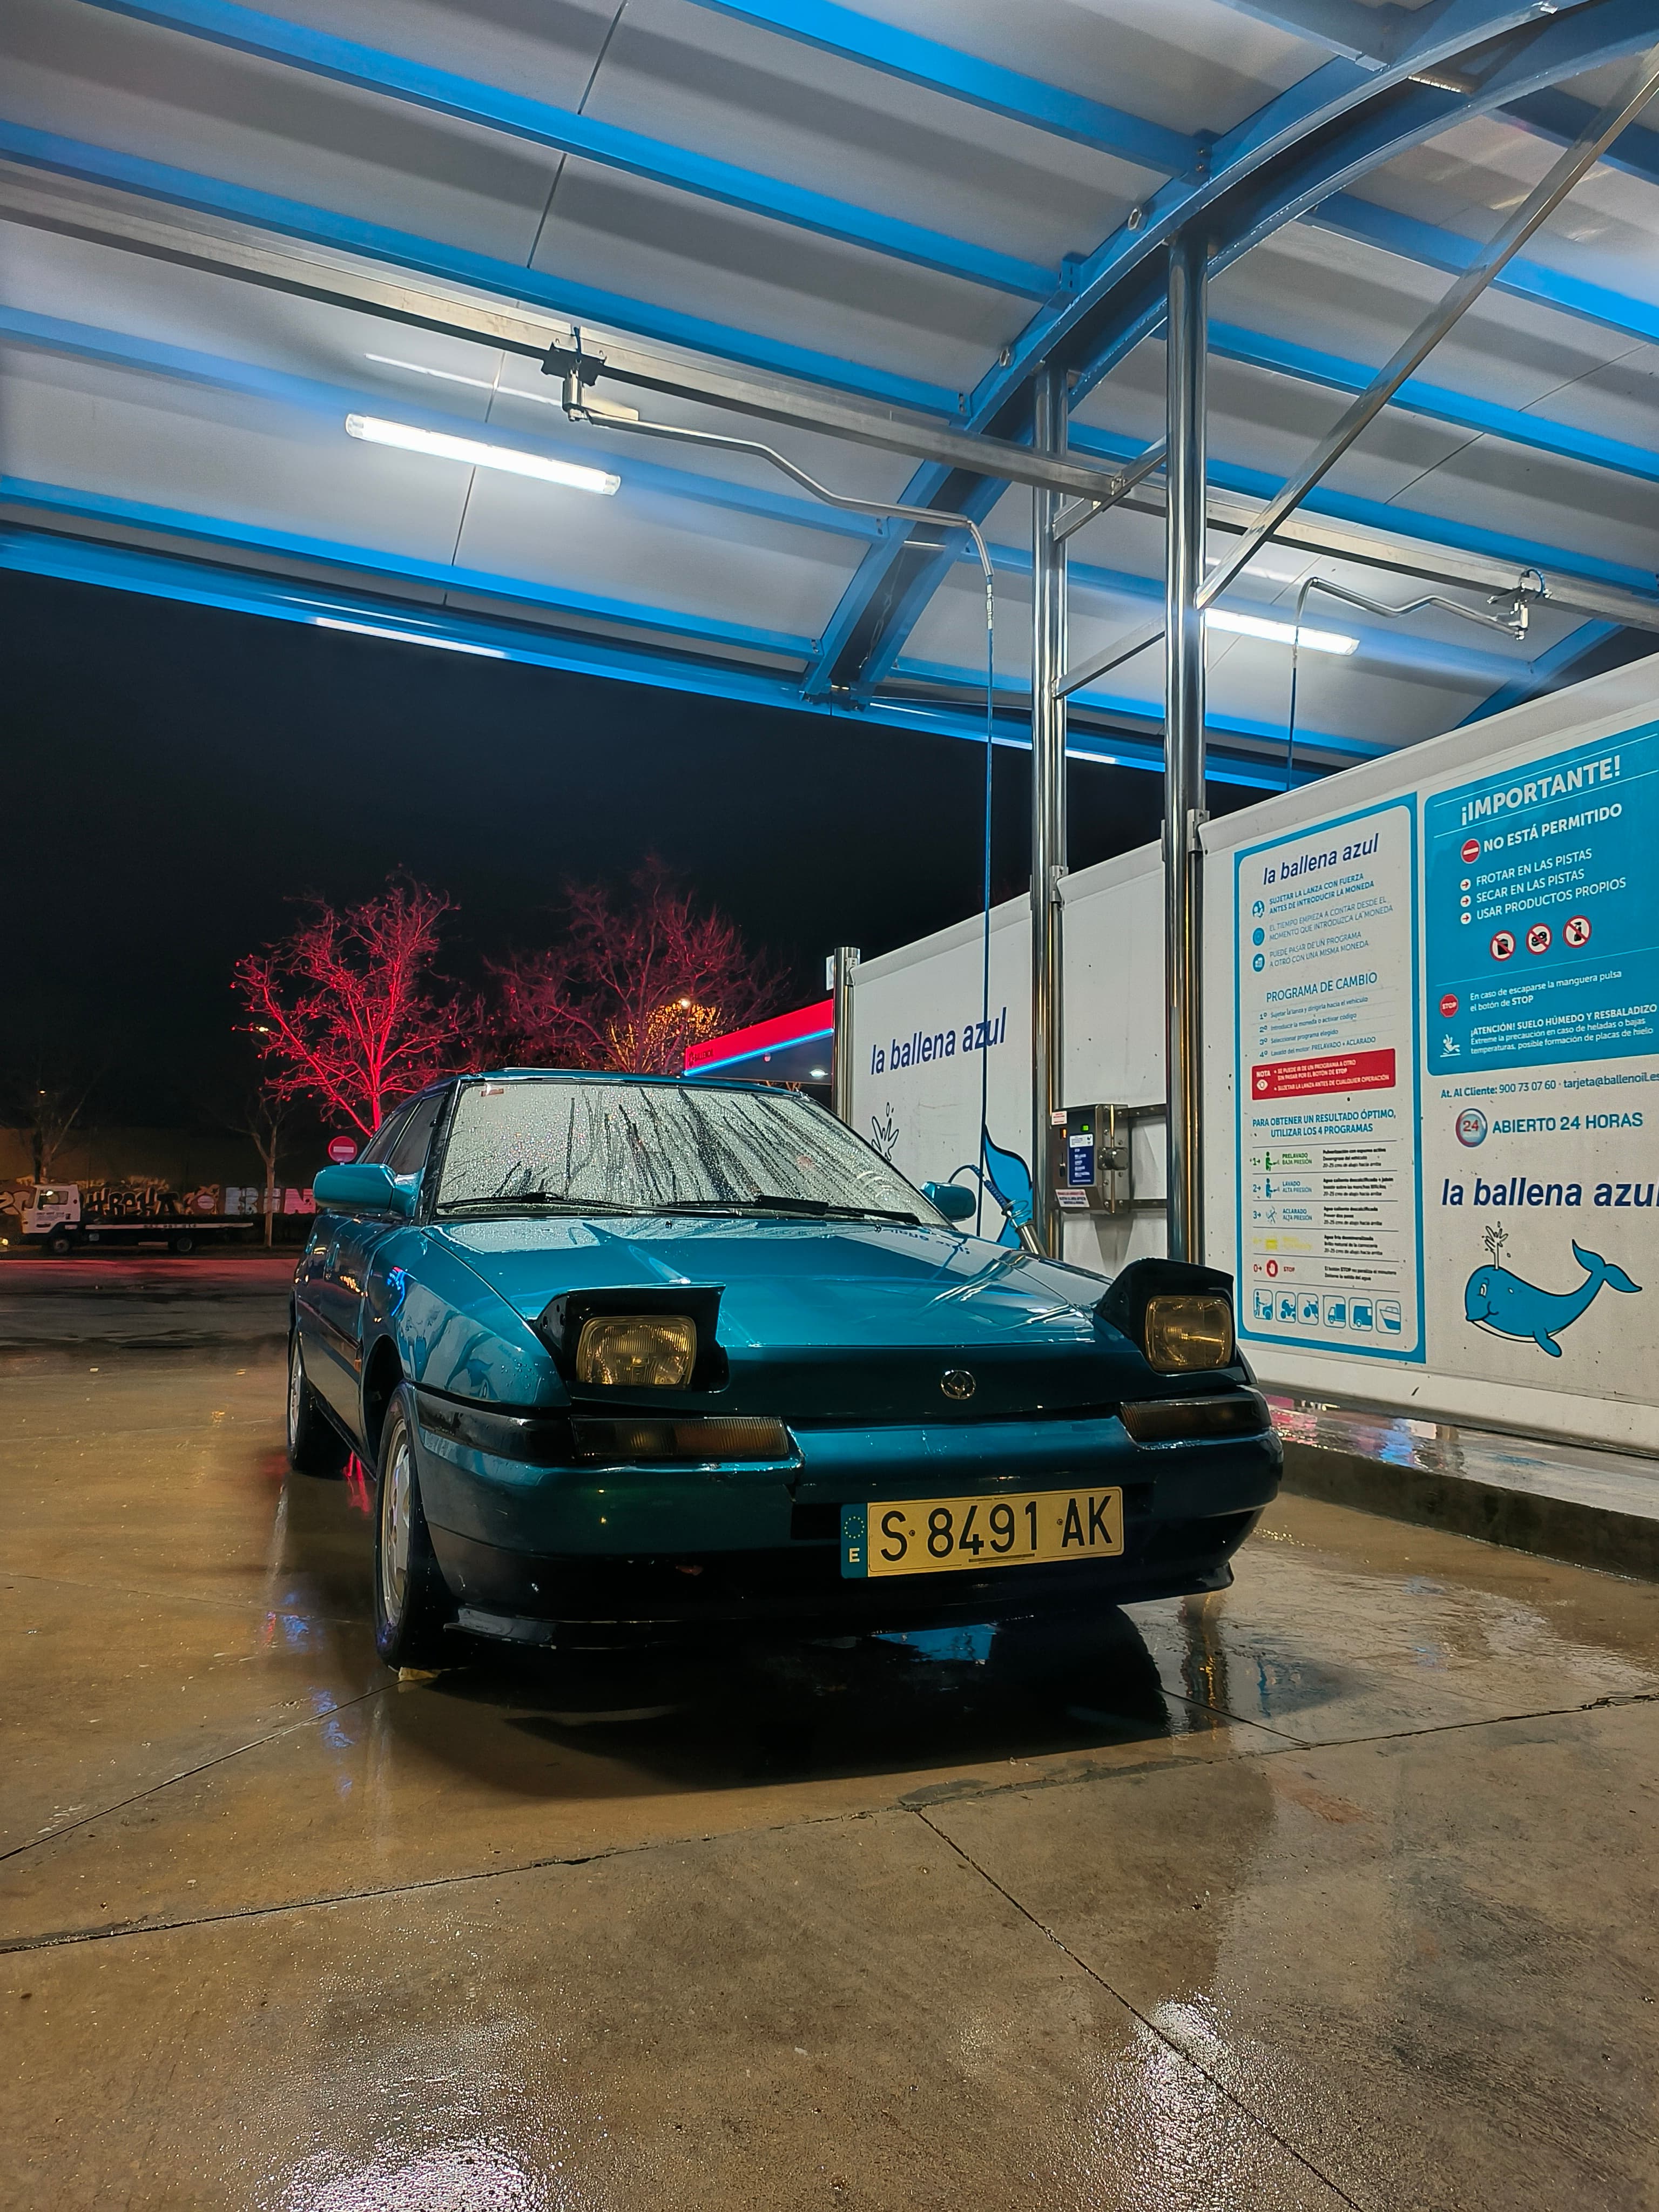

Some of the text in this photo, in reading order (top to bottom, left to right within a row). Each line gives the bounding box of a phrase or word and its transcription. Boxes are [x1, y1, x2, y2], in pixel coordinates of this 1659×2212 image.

[1461, 755, 1620, 825] ¡IMPORTANTE!
[1484, 804, 1622, 852] NO ESTÁ PERMITIDO
[1264, 833, 1379, 885] la ballena azul
[1476, 848, 1592, 886] FROTAR EN LAS PISTAS
[1270, 892, 1293, 905] SUJETAR
[1304, 885, 1323, 895] LANZA
[1324, 881, 1338, 889] CON
[1339, 873, 1363, 886] FUERZA
[1270, 903, 1287, 914] ANTES
[1289, 901, 1296, 909] DE
[1297, 891, 1334, 907] INTRODUCIR
[1345, 881, 1374, 894] MONEDA
[1476, 868, 1584, 903] SECAR EN LAS PISTAS
[1476, 877, 1626, 920] USAR PRODUCTOS PROPIOS
[1270, 928, 1299, 940] MOMENTO
[1300, 925, 1312, 933] QUE
[1314, 915, 1353, 930] INTRODUZCA
[1365, 905, 1393, 918] MONEDA
[1277, 919, 1298, 929] TIEMPO
[1299, 912, 1323, 924] EMPIEZA
[1330, 903, 1355, 916] CONTAR
[1357, 899, 1378, 909] DESDE
[1270, 931, 1361, 957] PUEDE PASAR DE UN PROGRAMA
[1275, 956, 1290, 966] OTRO
[1292, 953, 1305, 962] CON
[1306, 950, 1318, 960] UNA
[1320, 945, 1339, 956] MISMA
[1341, 940, 1368, 952] MONEDA
[1266, 972, 1377, 1002] PROGRAMA DE CAMBIO
[1470, 993, 1479, 1001] En
[1481, 990, 1496, 999] caso
[1498, 988, 1507, 996] de
[1509, 982, 1546, 995] escaparse
[1556, 975, 1597, 987] manguera
[1600, 970, 1622, 981] pulsa
[1478, 1000, 1499, 1010] botón
[1501, 999, 1510, 1007] de
[1512, 995, 1534, 1005] STOP
[1471, 1004, 1657, 1037] ¡ATENCIÓN! SUELO HÚMEDO Y RESBALADIZO
[1587, 1021, 1616, 1030] heladas
[871, 1007, 1007, 1075] la ballena azul
[1312, 1041, 1341, 1050] PRELAVADO
[1346, 1036, 1375, 1046] ACLARADO
[1545, 1034, 1582, 1046] formación
[1596, 1031, 1619, 1041] placas
[1454, 1089, 1462, 1097] Al
[1464, 1087, 1497, 1096] Cliente:
[1499, 1084, 1515, 1093] 900
[1519, 1083, 1529, 1091] 73
[1532, 1081, 1542, 1090] 07
[1545, 1080, 1556, 1089] 60
[1253, 1109, 1396, 1127] PARA OBTENER UN RESULTADO ÓPTIMO,
[1271, 1123, 1373, 1137] UTILIZAR LOS 4 PROGRAMAS
[1463, 1120, 1479, 1132] 24
[1493, 1112, 1643, 1134] ABIERTO 24 HORAS
[1253, 1184, 1257, 1192] 2
[1442, 1177, 1659, 1206] la ballena azu
[1253, 1211, 1257, 1219] 3
[880, 1495, 1112, 1562] S 8491 AK
[849, 1547, 860, 1563] E
